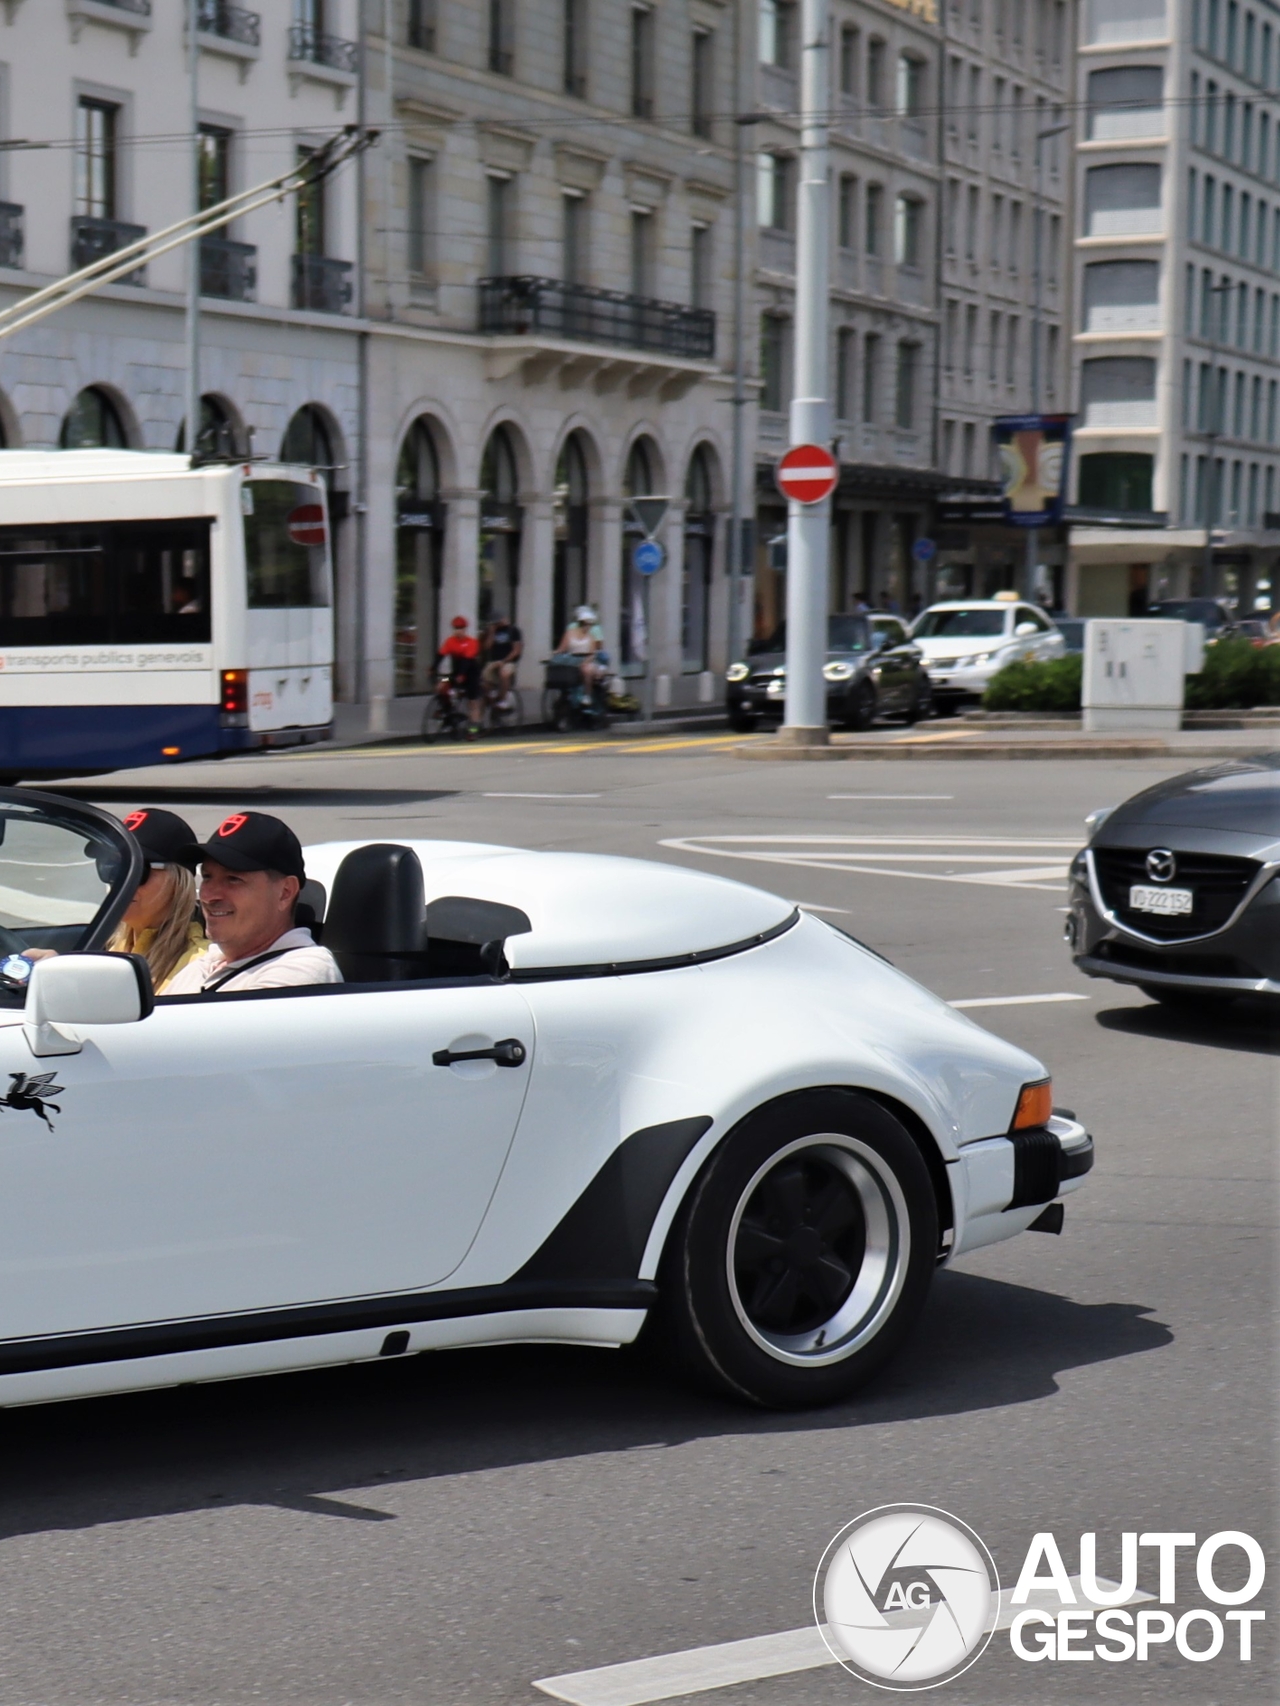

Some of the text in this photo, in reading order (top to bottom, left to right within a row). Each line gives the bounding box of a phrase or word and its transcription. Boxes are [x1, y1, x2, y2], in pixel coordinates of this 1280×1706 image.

[5, 653, 79, 668] transports
[81, 651, 132, 667] publics
[137, 649, 204, 667] genevois
